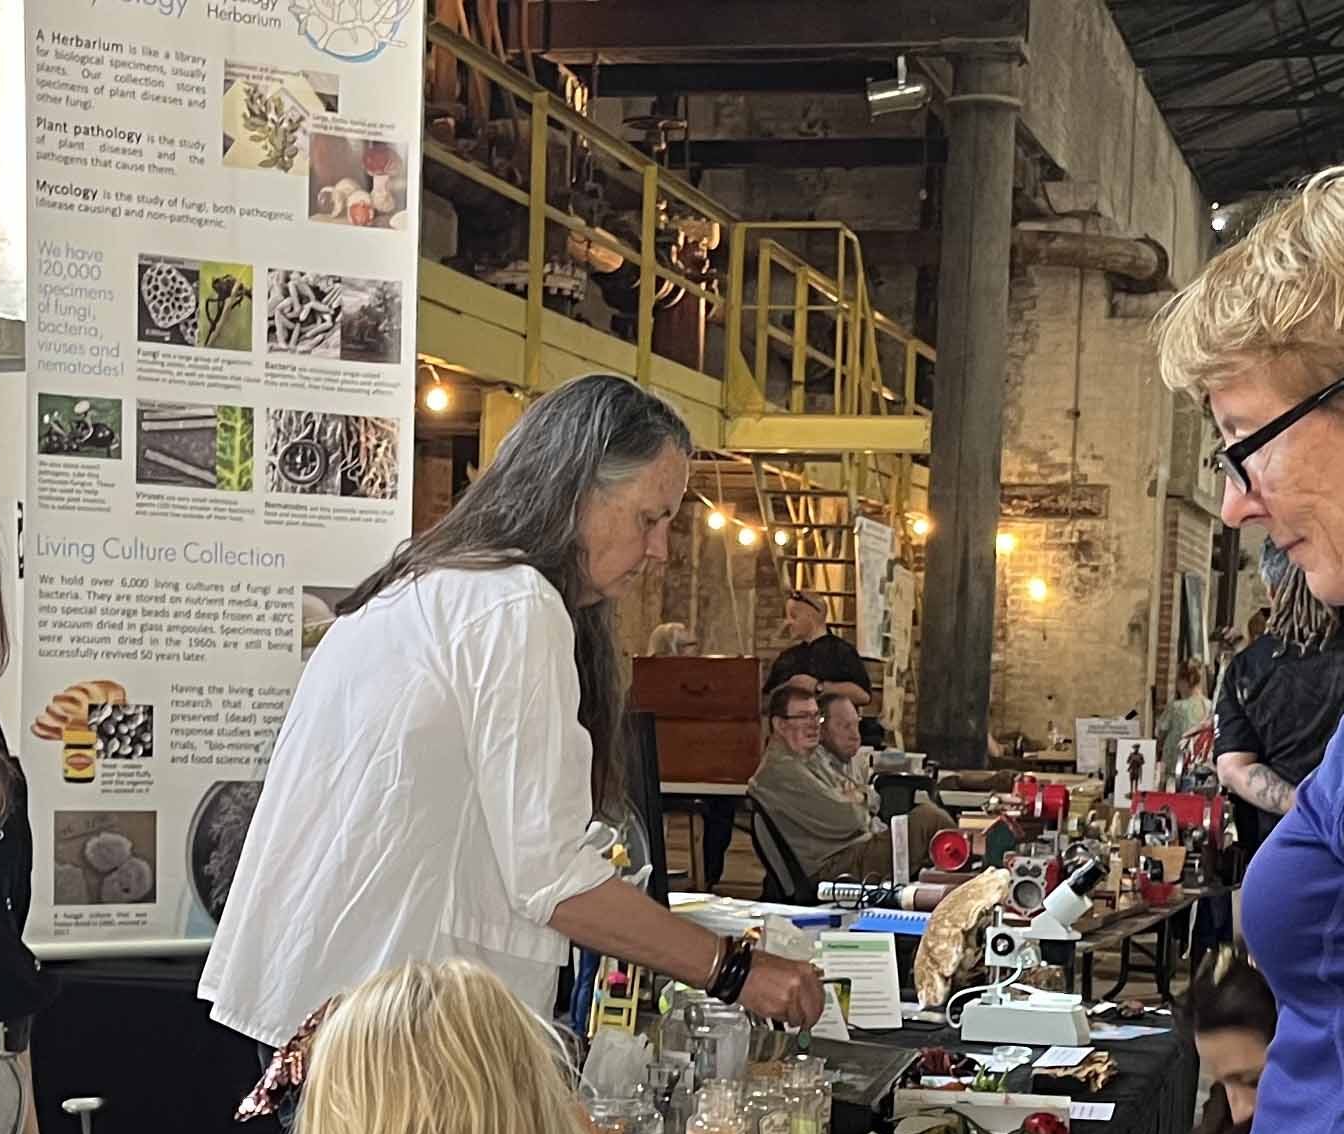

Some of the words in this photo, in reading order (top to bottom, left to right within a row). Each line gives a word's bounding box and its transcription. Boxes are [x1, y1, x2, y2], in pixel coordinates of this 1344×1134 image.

[207, 5, 281, 28] Herbarium
[36, 28, 44, 41] A
[51, 31, 123, 52] Herbarium
[36, 78, 88, 94] specimens
[93, 84, 103, 95] of
[109, 87, 135, 100] plant
[141, 91, 182, 107] diseases
[188, 97, 206, 110] and
[36, 116, 67, 133] Plant
[74, 124, 142, 145] pathology
[147, 134, 154, 144] is
[159, 136, 174, 146] the
[179, 138, 206, 152] study
[36, 135, 45, 144] of
[58, 138, 84, 151] plant
[99, 143, 143, 157] diseases
[157, 150, 176, 161] and
[189, 154, 205, 165] the
[36, 179, 98, 200] Mycology
[38, 240, 61, 258] We
[65, 245, 103, 263] have
[38, 260, 101, 281] 120,000
[38, 283, 113, 301] specimens
[38, 300, 52, 313] of
[55, 302, 95, 322] fungi,
[38, 319, 103, 339] bacteria,
[38, 337, 85, 356] viruses
[90, 343, 120, 359] and
[38, 359, 124, 377] nematodes!
[37, 533, 94, 564] Living
[103, 536, 176, 563] Culture
[184, 542, 286, 568] Collection
